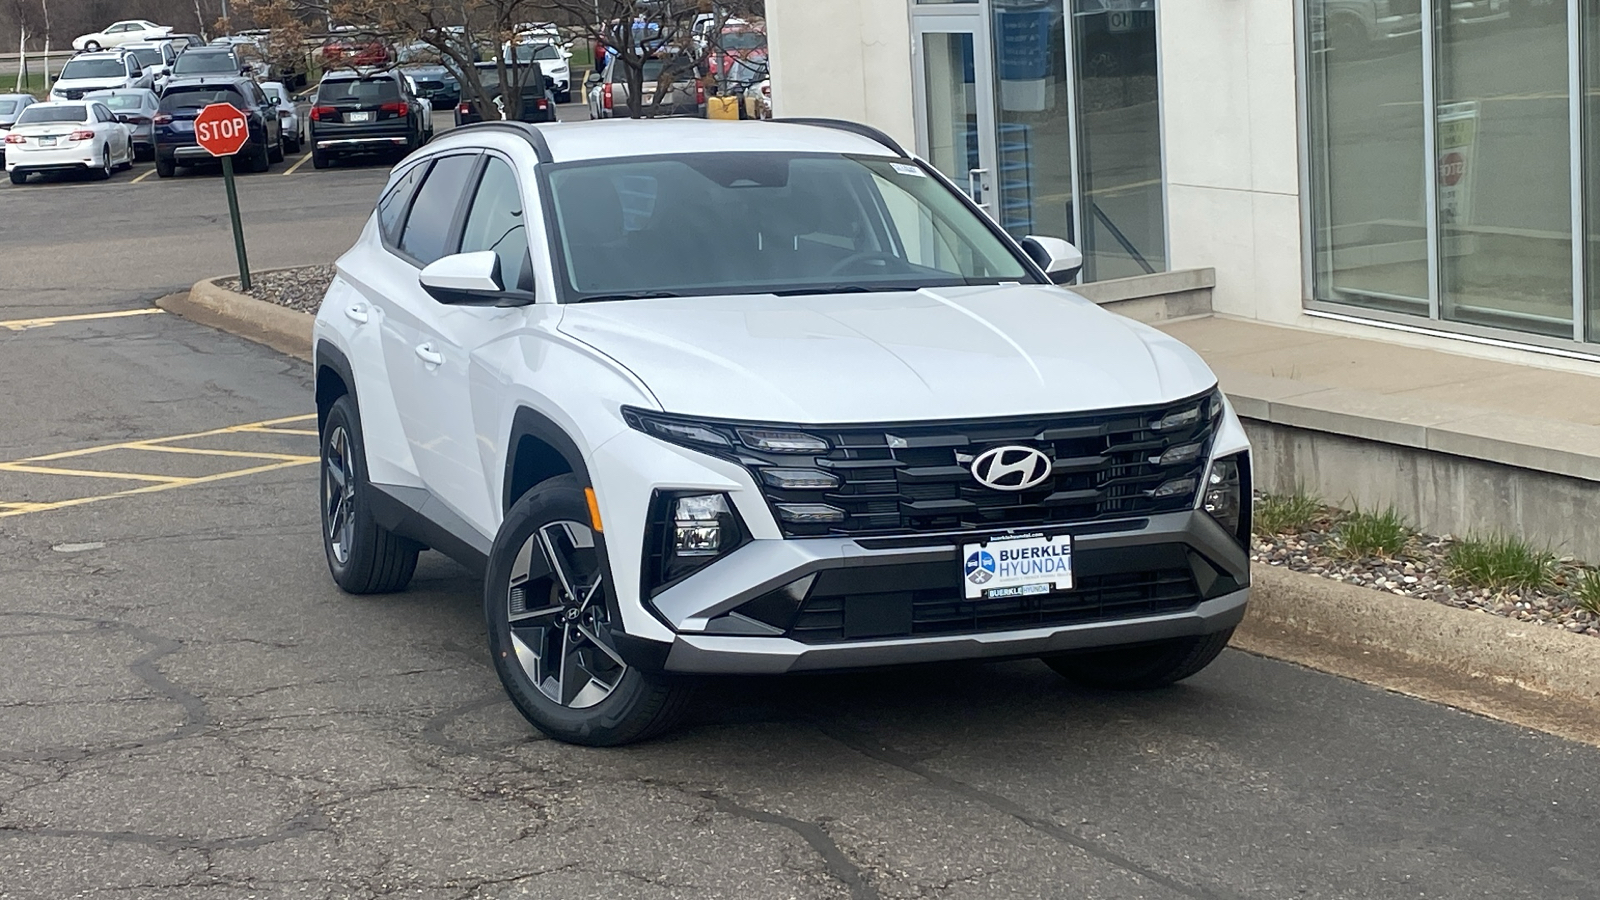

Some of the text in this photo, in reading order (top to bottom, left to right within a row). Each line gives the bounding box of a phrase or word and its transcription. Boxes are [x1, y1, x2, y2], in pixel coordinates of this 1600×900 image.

[198, 118, 244, 141] STOP
[1000, 545, 1070, 561] BUERKLE
[1000, 557, 1071, 577] HYUNDAI
[989, 585, 1048, 597] BUERKLE HYUNDAI
